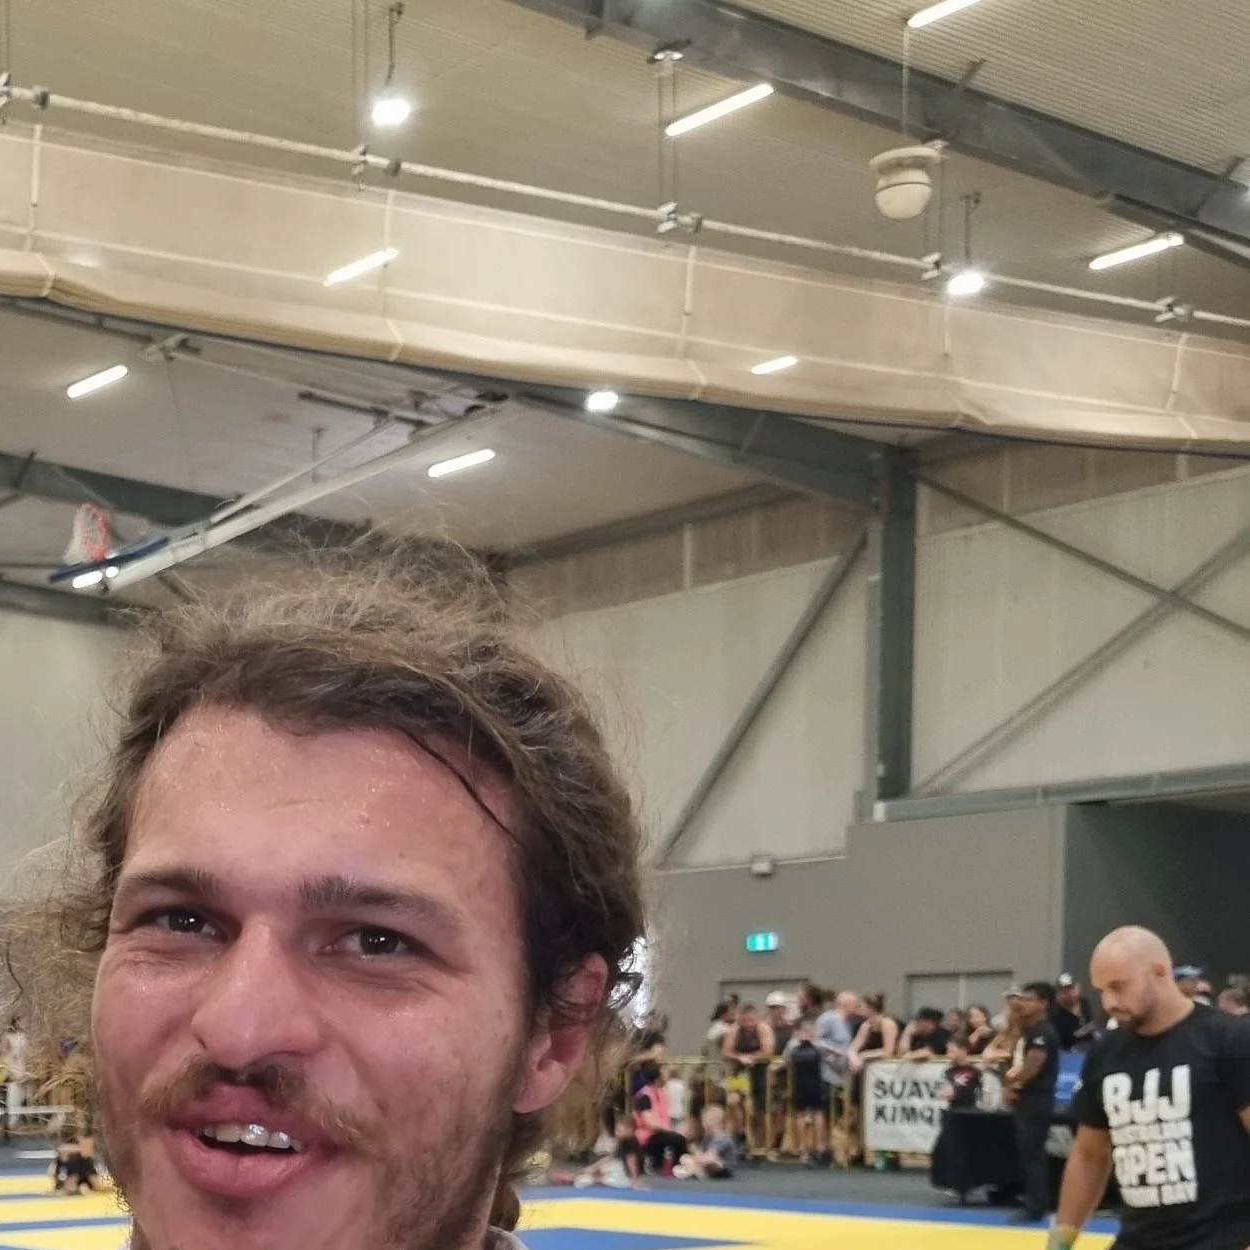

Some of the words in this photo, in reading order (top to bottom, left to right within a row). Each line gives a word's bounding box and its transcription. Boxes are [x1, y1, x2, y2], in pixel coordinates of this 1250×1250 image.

[874, 1079, 948, 1099] SUAV
[1103, 1065, 1191, 1127] BJJ
[1112, 1140, 1196, 1186] OPEN
